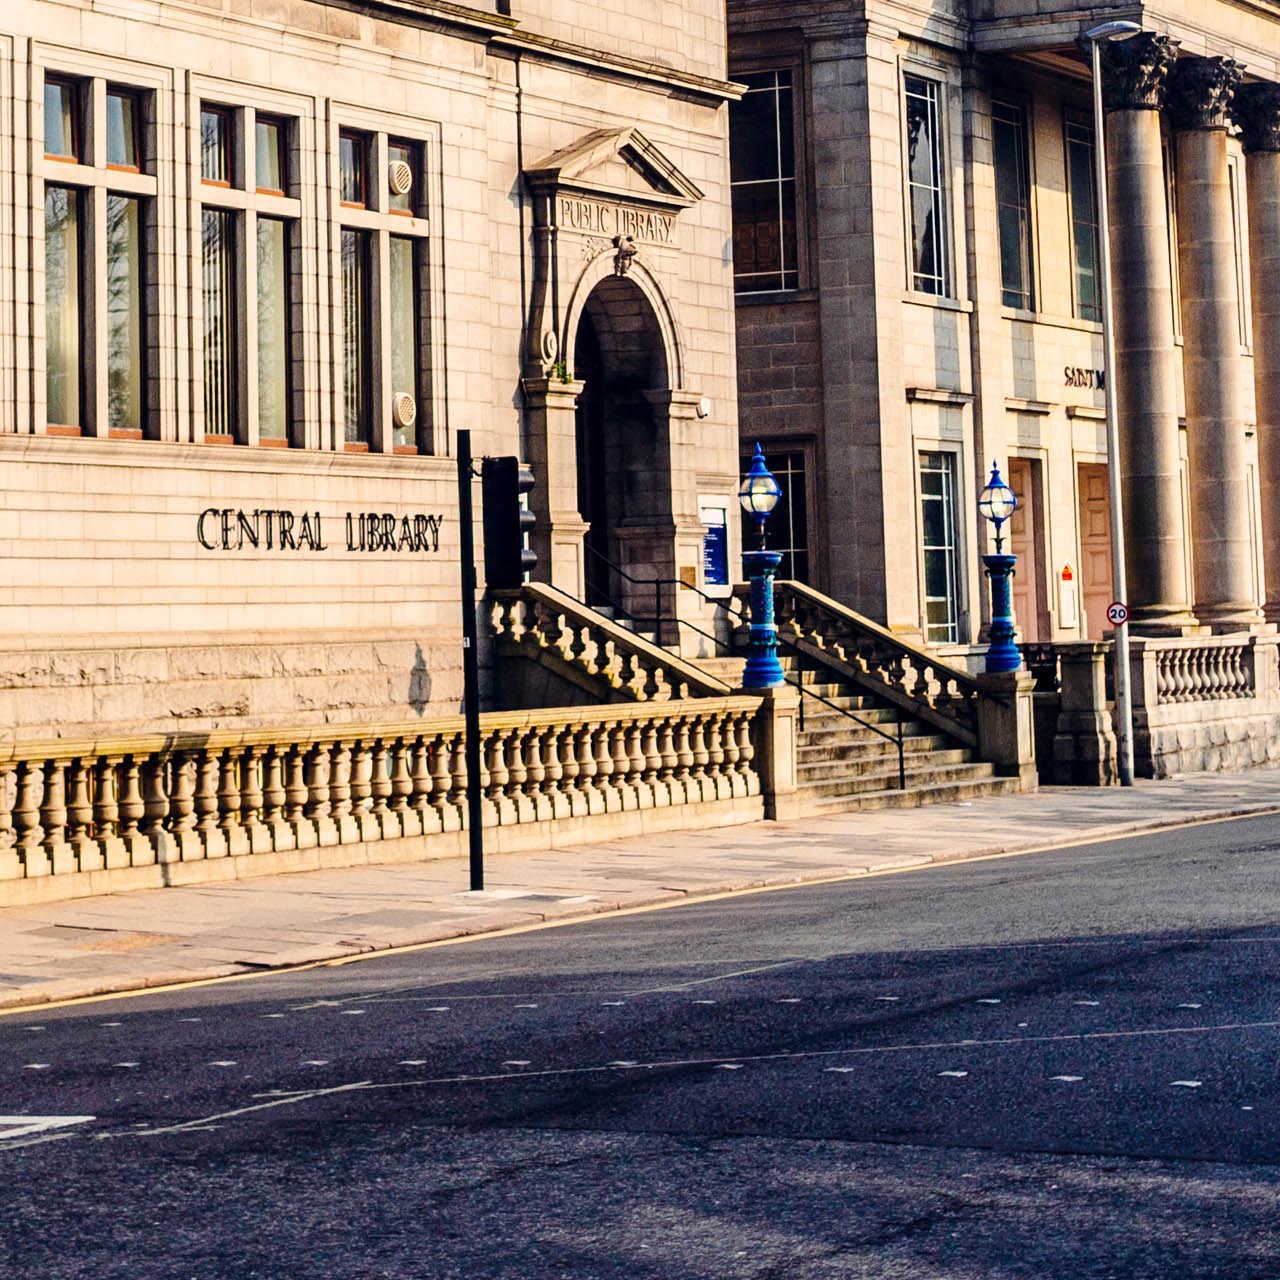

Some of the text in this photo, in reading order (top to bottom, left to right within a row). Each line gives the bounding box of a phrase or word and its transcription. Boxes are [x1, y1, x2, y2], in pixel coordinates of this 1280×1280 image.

[560, 199, 609, 233] PUBLIC
[1064, 366, 1094, 389] SAINT
[197, 507, 443, 553] CENTRAL LIBRARY
[1110, 609, 1126, 619] 20
